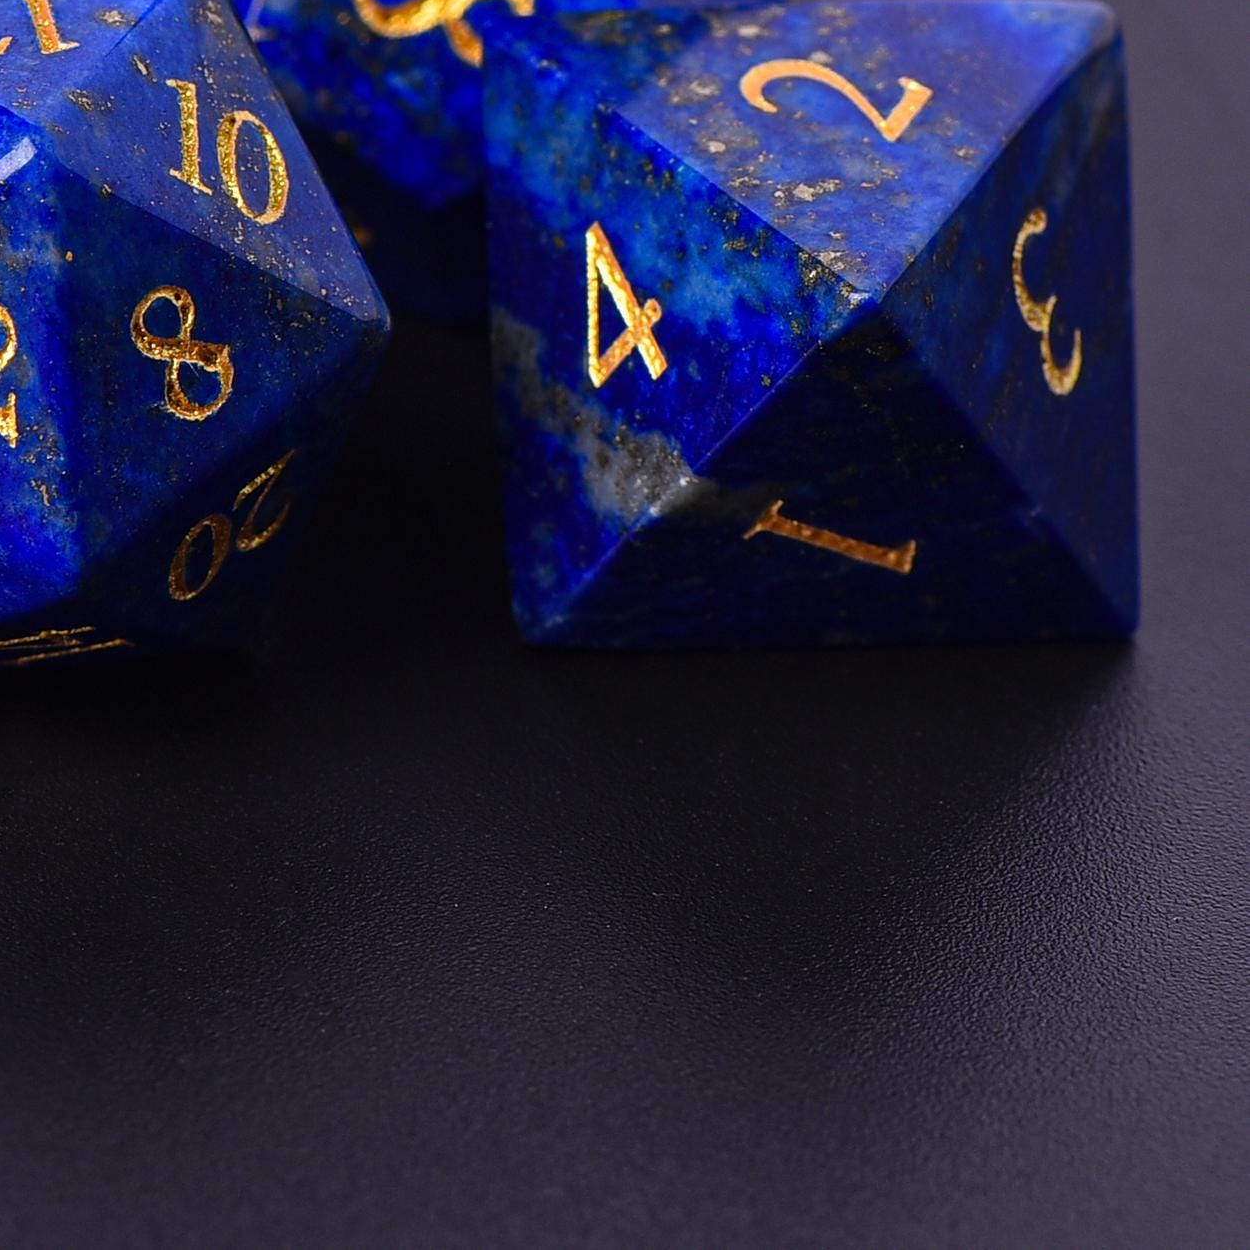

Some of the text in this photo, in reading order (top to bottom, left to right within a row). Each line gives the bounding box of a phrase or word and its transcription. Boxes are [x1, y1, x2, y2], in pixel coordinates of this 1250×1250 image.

[166, 78, 290, 225] 10
[740, 58, 934, 143] 2
[129, 284, 234, 422] 8
[584, 220, 669, 390] 4
[1011, 207, 1083, 397] 3
[168, 450, 295, 602] 20
[742, 498, 917, 575] 1
